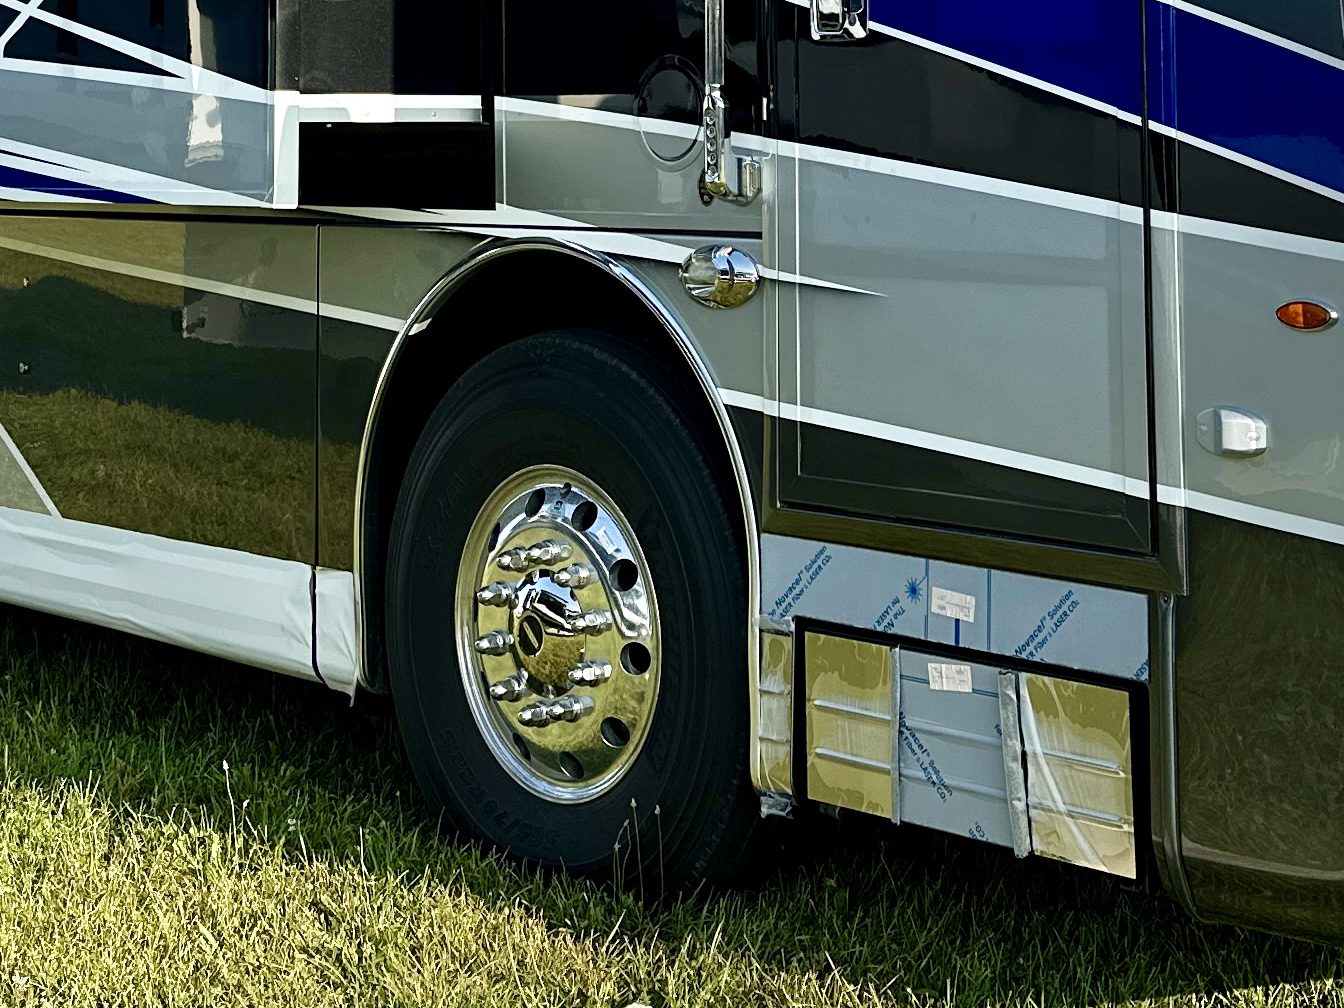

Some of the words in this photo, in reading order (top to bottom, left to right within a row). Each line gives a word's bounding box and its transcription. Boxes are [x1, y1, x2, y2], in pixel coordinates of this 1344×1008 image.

[807, 564, 824, 585] LASER
[1047, 589, 1074, 621] Solution
[1051, 610, 1070, 634] LASER
[919, 761, 937, 788] LASER
[928, 757, 954, 796] Solution
